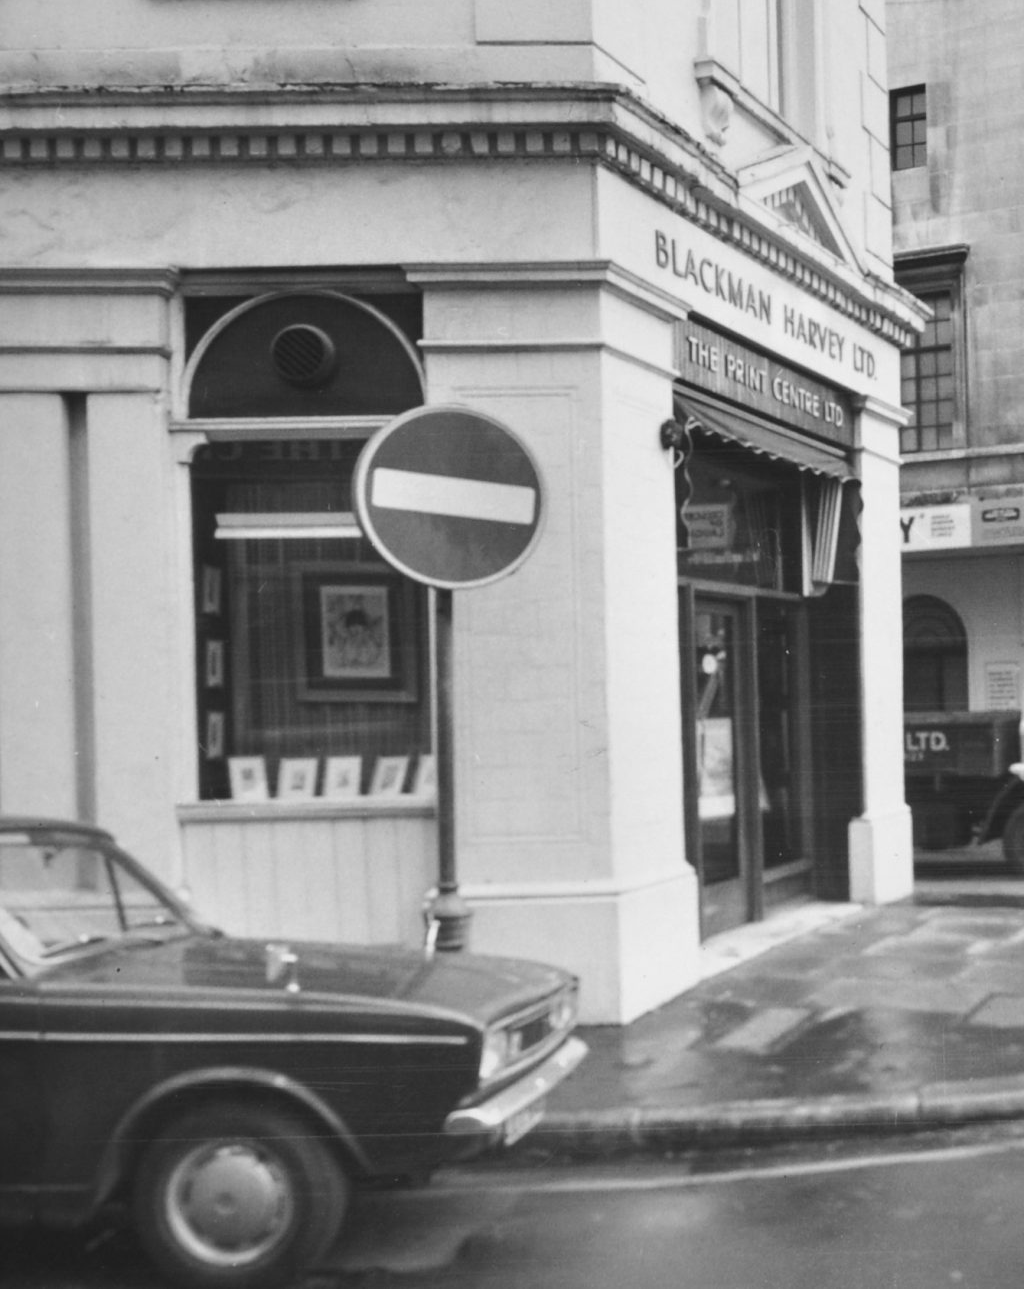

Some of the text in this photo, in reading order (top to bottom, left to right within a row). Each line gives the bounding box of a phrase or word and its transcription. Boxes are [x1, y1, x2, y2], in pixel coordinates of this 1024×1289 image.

[655, 229, 771, 325] BLACKMAN
[784, 303, 845, 363] HARVEY
[687, 335, 844, 427] THE PRINT CENTRE LTD
[906, 731, 950, 752] LTD.
